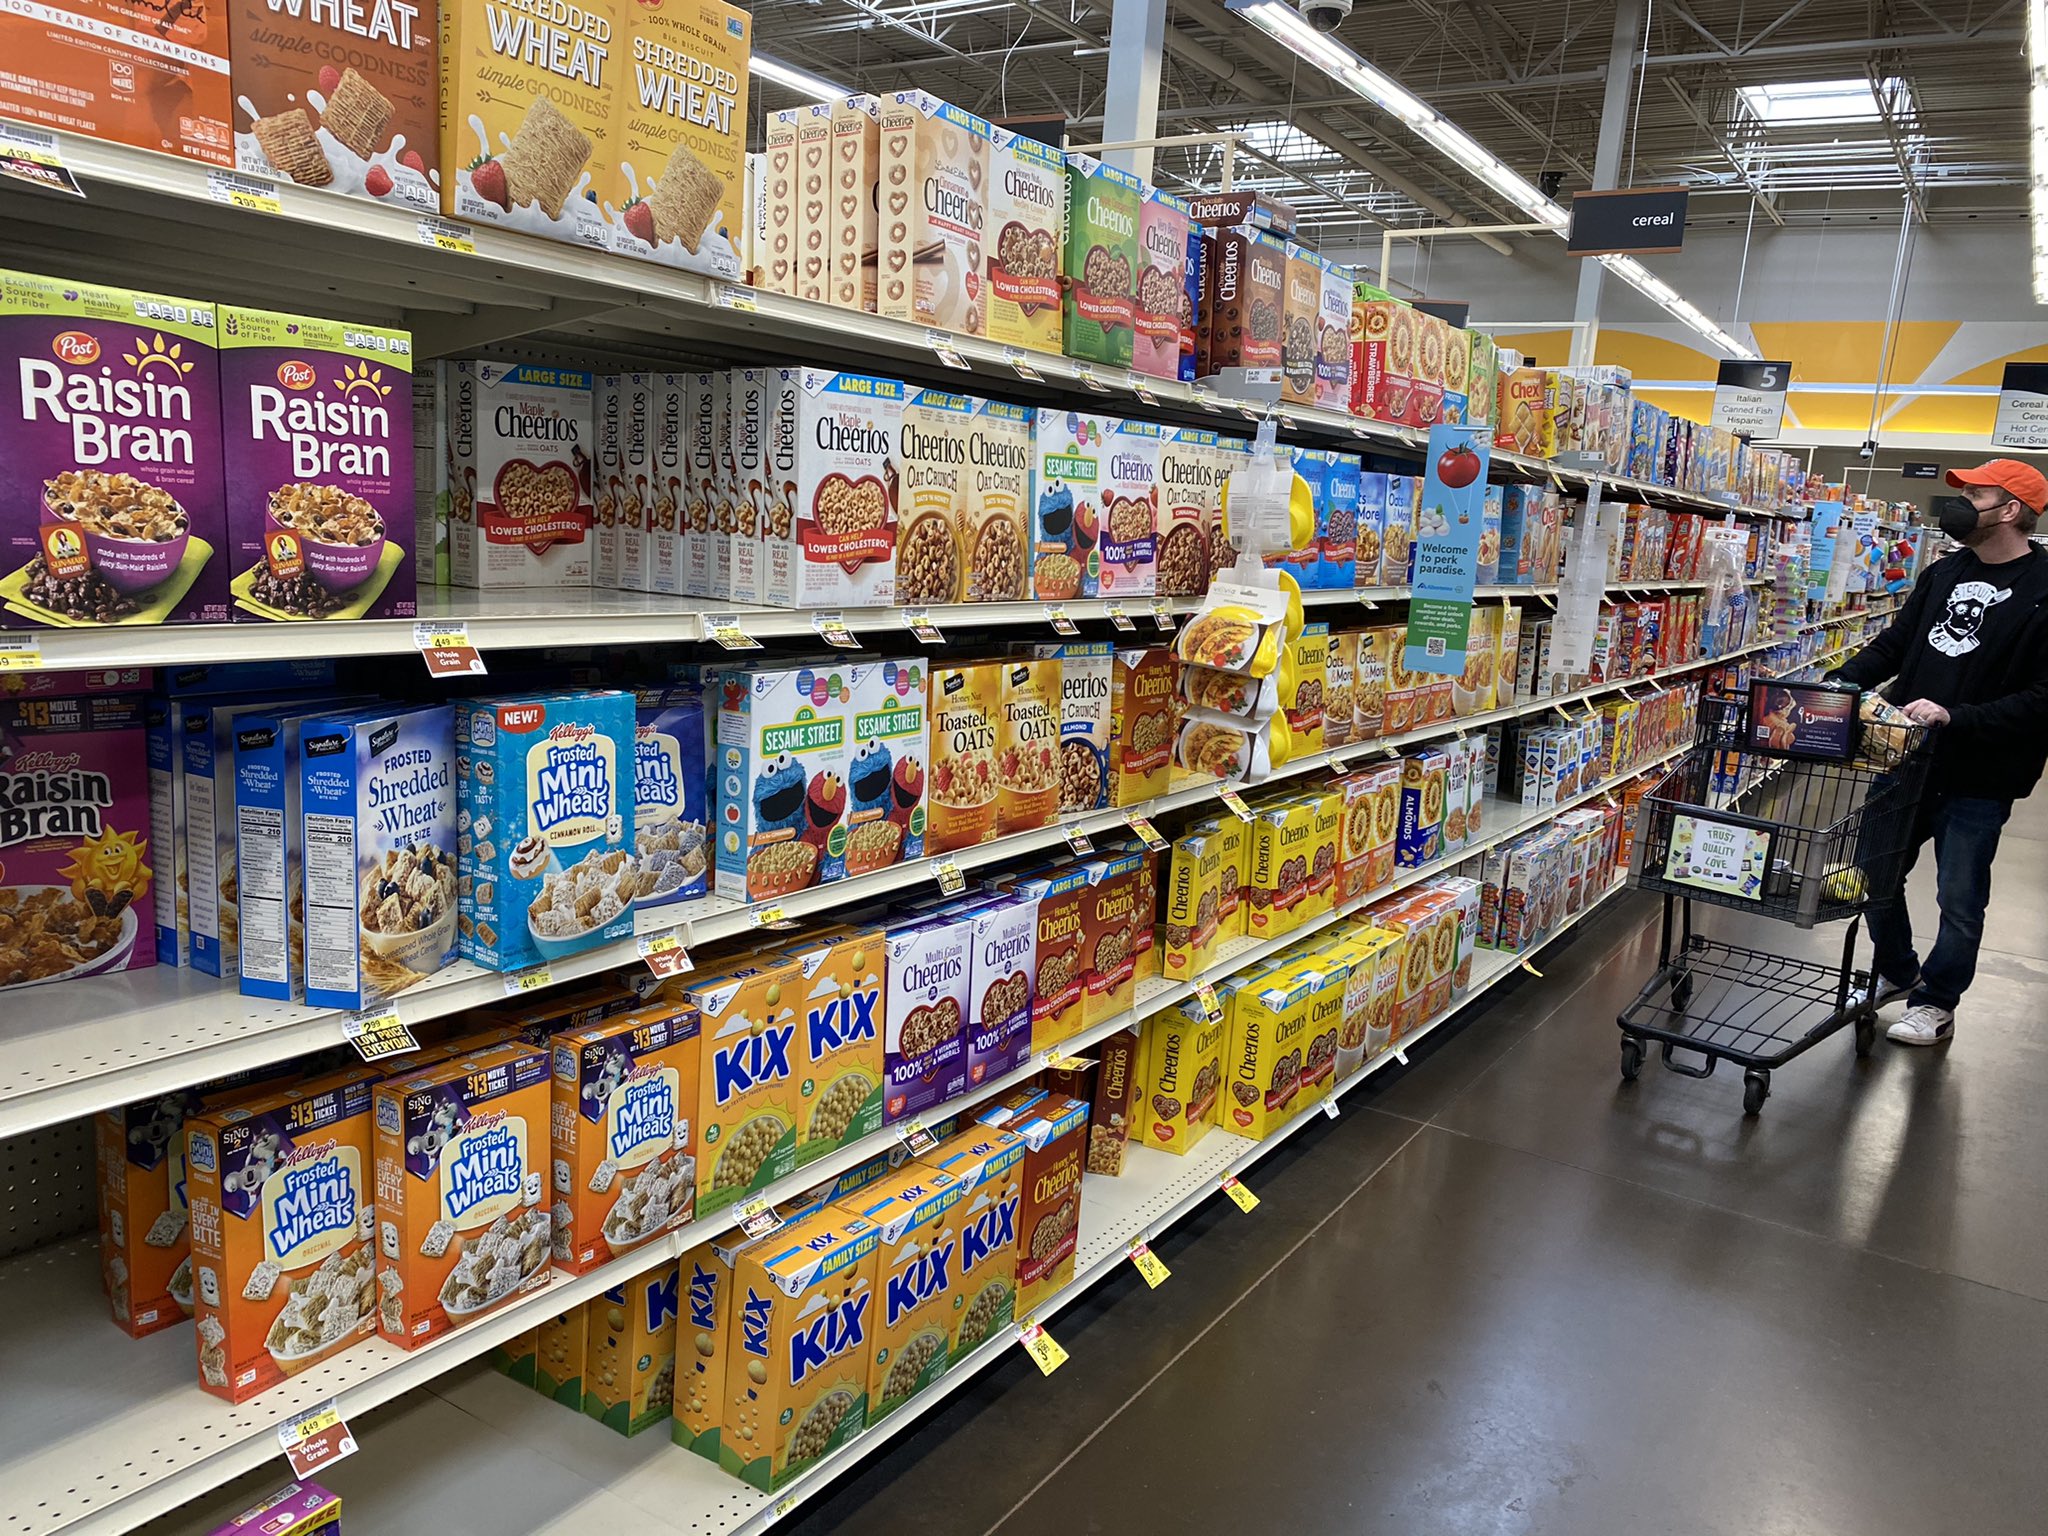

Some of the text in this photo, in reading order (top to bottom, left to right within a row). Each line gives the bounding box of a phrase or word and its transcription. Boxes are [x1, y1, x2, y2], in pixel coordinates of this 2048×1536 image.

[44, 10, 94, 31] YEARS
[103, 26, 122, 38] OF
[131, 34, 217, 67] CHAMPIONS
[486, 4, 608, 89] WHEAT
[648, 15, 727, 55] 100% WHOLE GRAIN
[46, 31, 190, 76] LIMITED EDITION CENTURY COLLECTOR SERIES
[633, 36, 739, 95] SHREDDED
[634, 64, 735, 135] WHEAT
[945, 105, 987, 136] LARGE SIZE
[627, 117, 737, 164] simple GOODNESS
[1005, 170, 1054, 208] Cheerios
[1190, 199, 1241, 220] Cheerios
[1632, 211, 1674, 227] cereal
[1146, 226, 1181, 260] Cheerios
[5, 277, 55, 292] Excellent
[6, 287, 43, 299] Source
[81, 289, 109, 300] Heart
[22, 298, 50, 310] Fiber
[83, 298, 121, 311] Healthy
[61, 336, 93, 356] Post
[519, 368, 583, 387] LARGE SIZE
[1366, 343, 1377, 403] STRAWBERRIES
[1760, 367, 1777, 388] 5
[19, 357, 191, 424] Raisin
[1510, 382, 1539, 399] Chex
[1736, 395, 1762, 403] Italian
[250, 384, 390, 442] Raisin
[520, 403, 545, 417] Maple
[1722, 405, 1753, 414] Canned
[2011, 400, 2043, 408] Cereal
[494, 406, 579, 442] Cheerios
[776, 389, 795, 471] Cheerios
[1727, 417, 1763, 426] Hispanic
[71, 413, 193, 465] Bran
[816, 416, 890, 454] Cheerios
[901, 423, 965, 465] Cheerios
[2003, 435, 2026, 443] Fruit
[291, 433, 390, 478] Bran
[855, 457, 872, 466] OATS
[907, 465, 958, 493] OAT CRUNCH
[1046, 458, 1097, 479] SESAME STREET
[1111, 455, 1153, 482] Cheerios
[1162, 456, 1211, 487] Cheerios
[97, 548, 166, 561] made with hundreds of
[808, 539, 889, 554] LOWER CHOLESTEROL
[1422, 543, 1468, 555] Welcome
[58, 564, 85, 574] RAISINS
[99, 559, 115, 569] juicy
[146, 563, 168, 571] Raisins
[1419, 564, 1466, 576] paradise.
[1421, 554, 1458, 566] to perk
[1360, 651, 1377, 665] Oats
[951, 693, 981, 704] Honey Nut
[504, 709, 539, 726] NEW!
[937, 708, 987, 732] Toasted
[1063, 723, 1087, 732] ALMOND
[1805, 712, 1844, 724] Dynamics
[549, 722, 596, 742] Kellogg's
[766, 723, 841, 751] SESAME STREET
[953, 728, 996, 753] OATS
[15, 752, 80, 772] Kellogg's
[384, 749, 432, 774] FROSTED
[550, 742, 596, 765] Frosted
[368, 763, 449, 808] Shredded
[541, 759, 605, 801] Mini
[381, 798, 437, 833] Wheat
[536, 783, 608, 827] Wheats
[1403, 794, 1415, 841] ALMONDS
[1, 803, 98, 843] Bran
[550, 825, 597, 840] CINNAMON ROLL
[395, 827, 431, 848] BITE SIZE
[1708, 830, 1736, 843] TRUST
[1702, 842, 1736, 857] QUALITY
[1705, 857, 1728, 869] LOVE
[1172, 866, 1191, 920] Cheerios
[1038, 913, 1081, 943] Cheerios
[925, 944, 963, 963] Multi Grain
[985, 933, 1030, 968] Cheerios
[903, 957, 962, 994] Cheerios
[1346, 971, 1370, 1012] CORN FLAKES
[356, 1026, 406, 1047] LOW PRICE
[808, 987, 879, 1064] KIX
[1276, 1013, 1306, 1043] Cheerios
[364, 1036, 411, 1057] EVERYDAY
[715, 1023, 796, 1106] KIX
[894, 1060, 923, 1080] 100%
[627, 1077, 664, 1104] Frosted
[291, 1094, 335, 1127] $13 MOVIE
[314, 1105, 338, 1121] TICKET
[620, 1088, 669, 1132] Mini
[223, 1127, 250, 1145] SING
[614, 1119, 672, 1157] Wheats
[287, 1139, 337, 1168] Kellogg's
[287, 1158, 338, 1190] Frosted
[278, 1171, 349, 1227] Mini
[914, 1189, 958, 1225] FAMILY SIZE
[273, 1201, 353, 1254] Wheats
[886, 1241, 954, 1327] KIX
[790, 1291, 871, 1386] KIX
[300, 1437, 328, 1455] Whole
[306, 1446, 330, 1462] Grain
